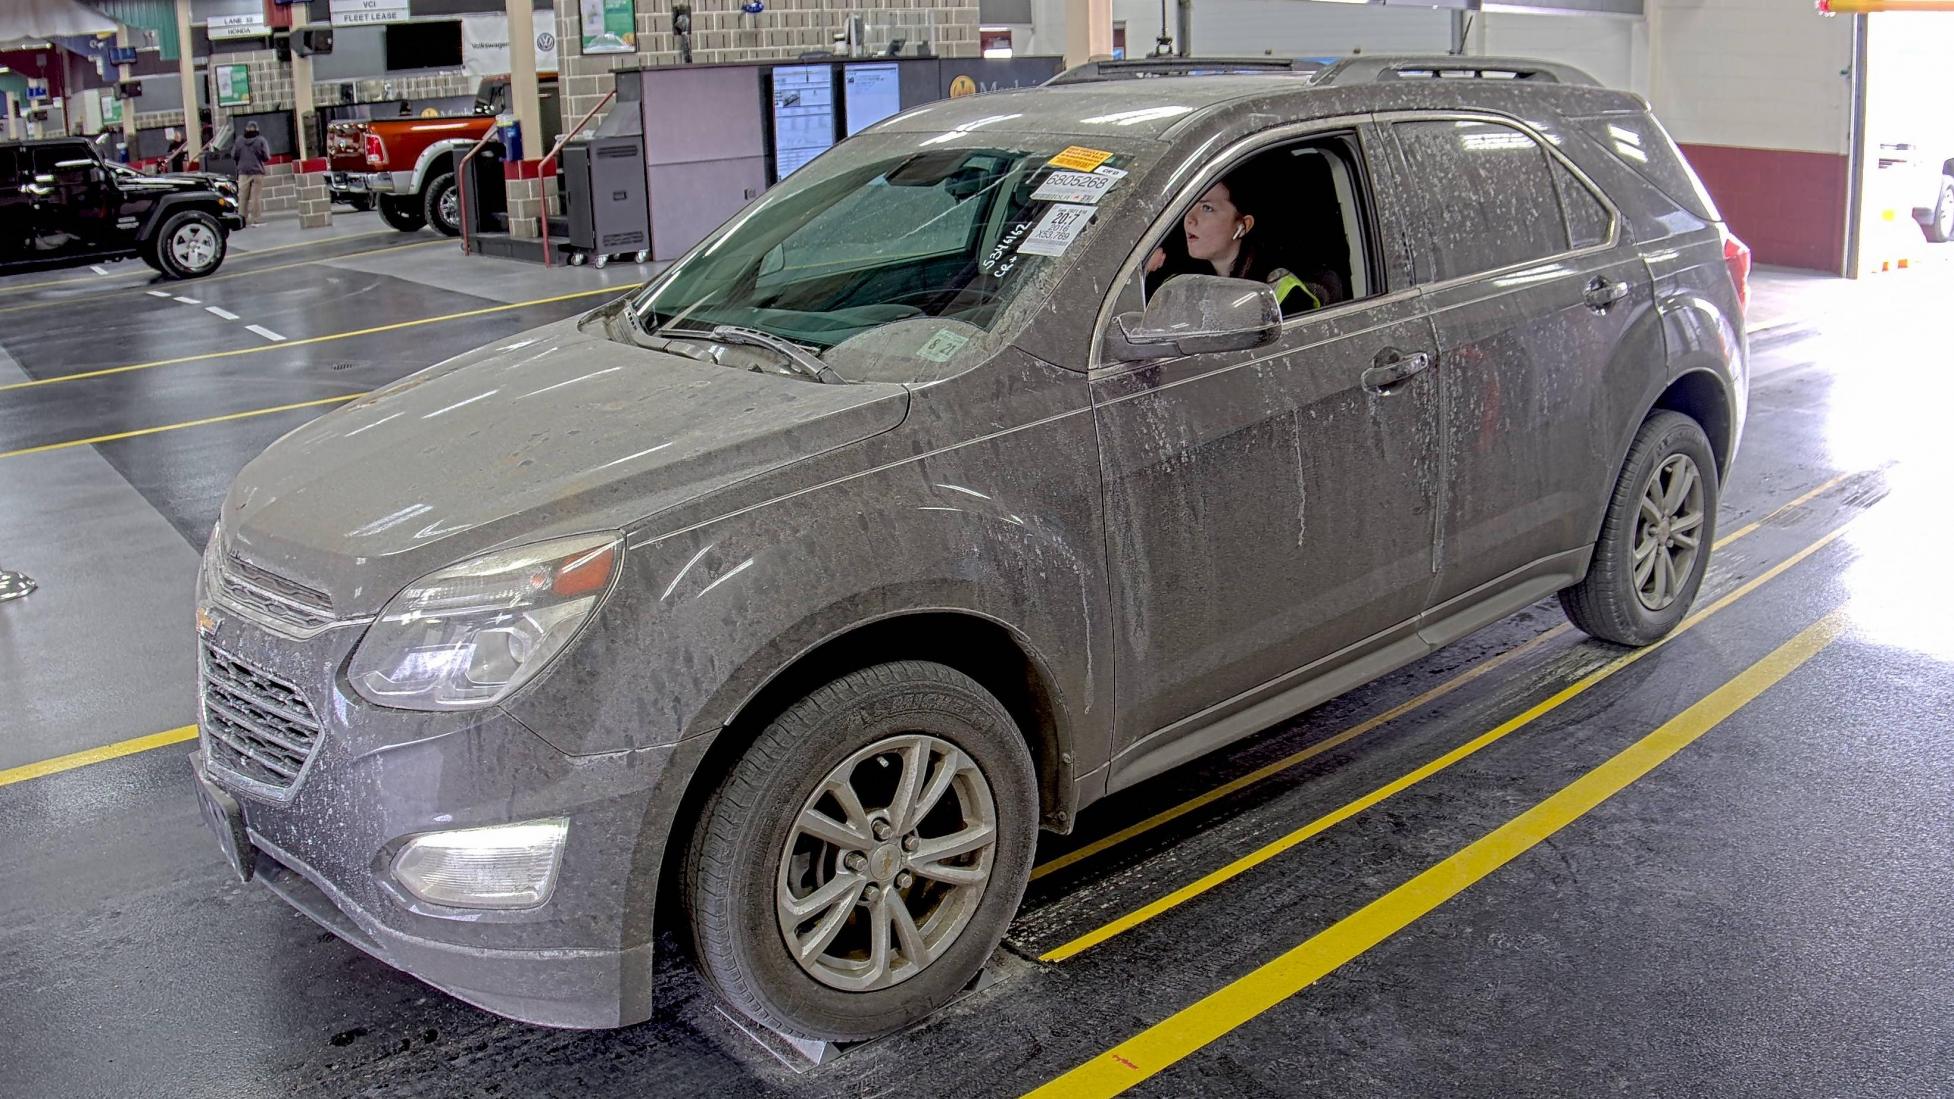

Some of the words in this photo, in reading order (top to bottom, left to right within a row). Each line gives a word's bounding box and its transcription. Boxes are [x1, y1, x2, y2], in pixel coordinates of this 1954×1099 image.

[344, 14, 369, 22] FLEET
[370, 12, 397, 20] LEASE
[1046, 174, 1109, 189] 6805268
